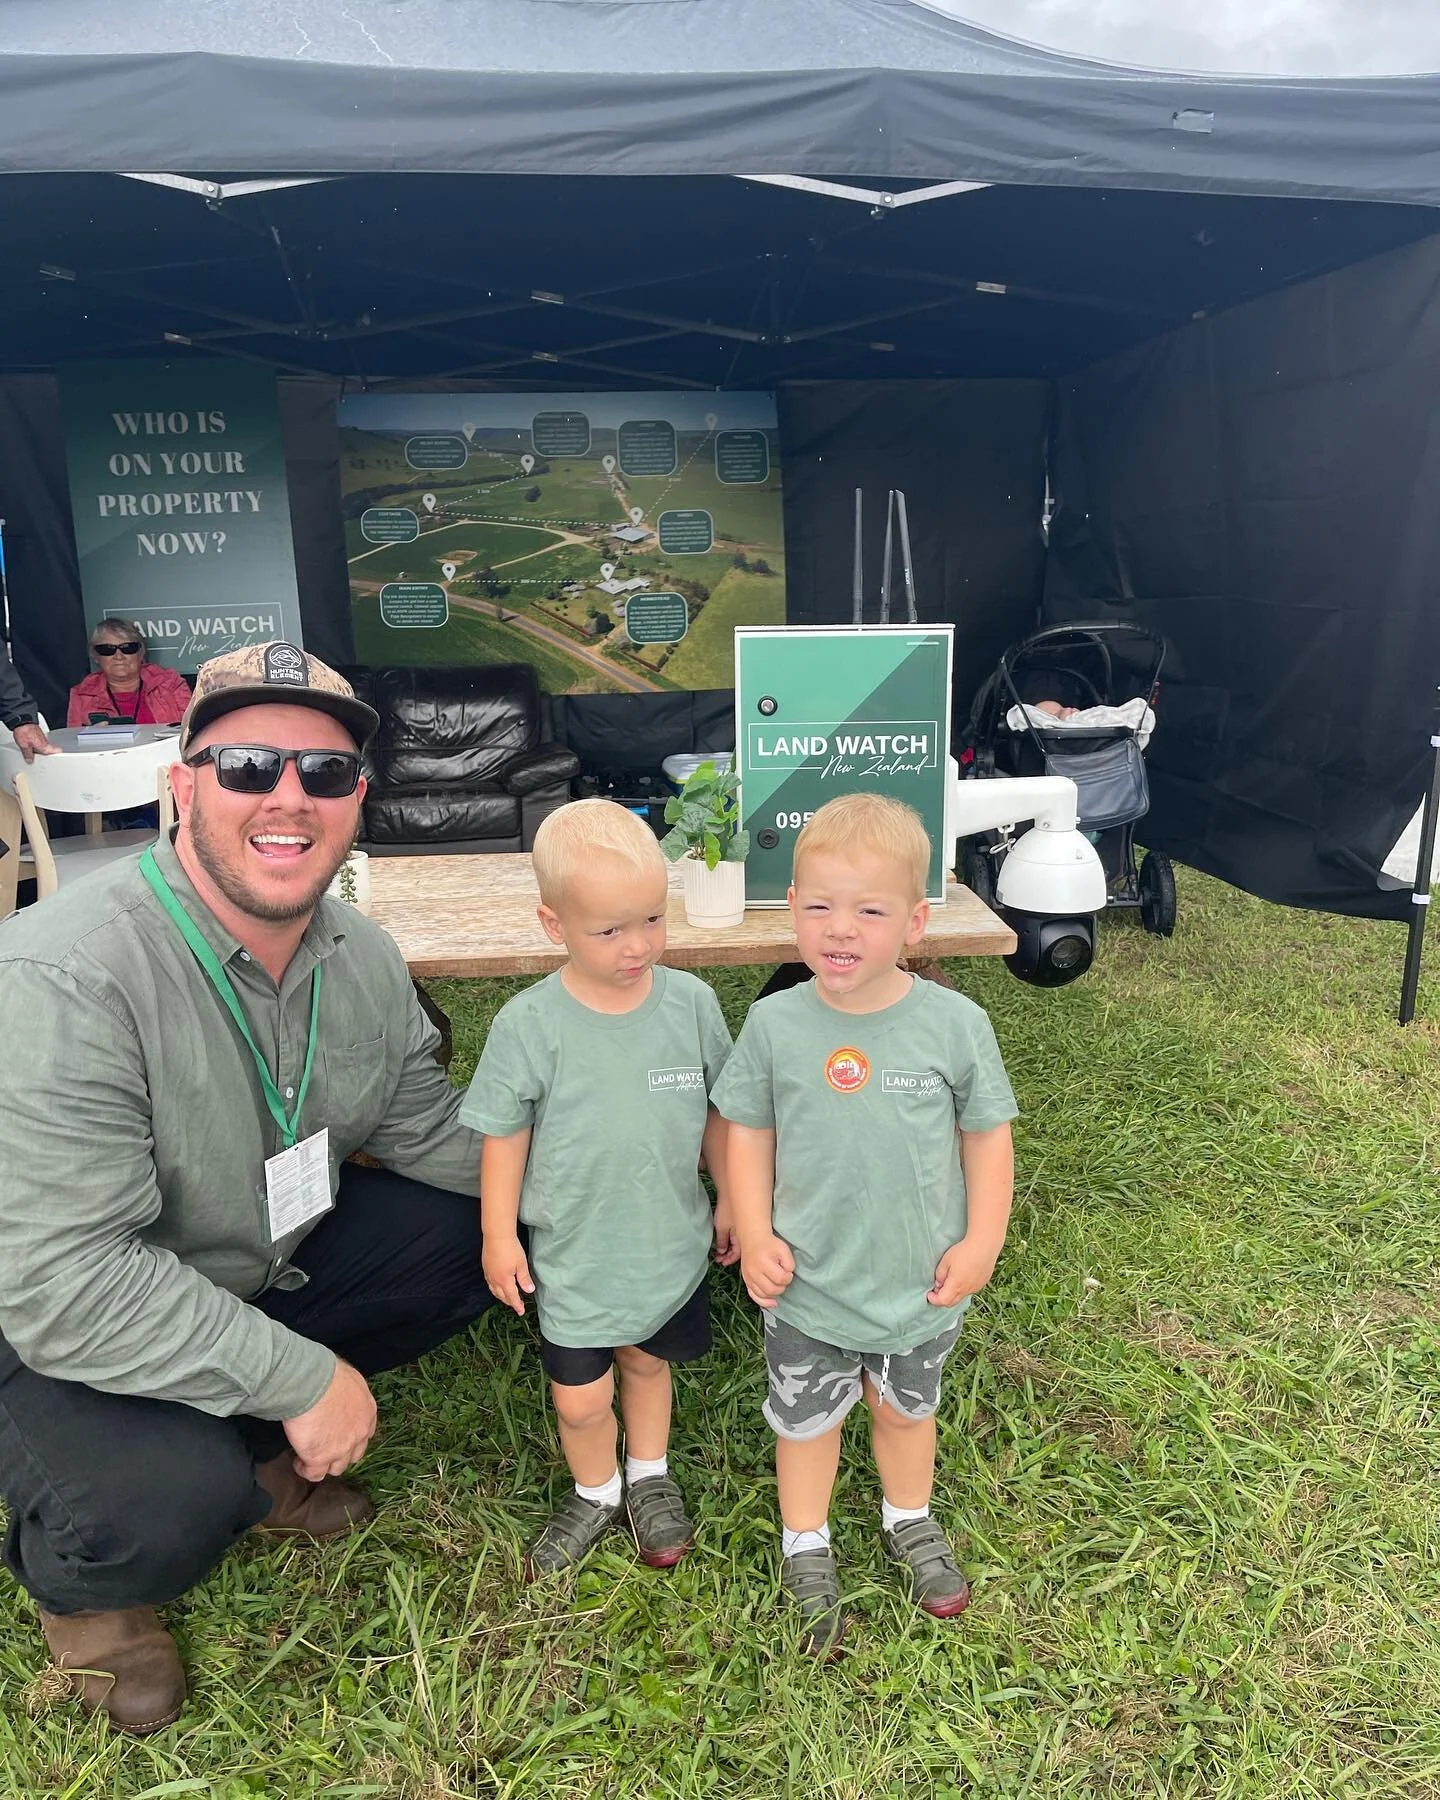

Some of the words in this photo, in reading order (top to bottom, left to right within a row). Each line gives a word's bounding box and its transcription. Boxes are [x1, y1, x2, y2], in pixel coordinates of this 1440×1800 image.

[112, 411, 190, 436] WHO
[198, 411, 226, 434] IS
[109, 453, 152, 477] ON
[160, 451, 246, 475] YOUR
[97, 490, 264, 517] PROPERTY
[137, 531, 228, 556] NOW?
[132, 617, 182, 638] AND
[187, 615, 275, 636] WATCH
[177, 635, 208, 658] New
[270, 668, 304, 677] HUNTERS
[270, 673, 304, 682] ELEMENT
[757, 736, 828, 757] LAND
[835, 735, 928, 755] WATCH
[820, 755, 855, 779] New
[858, 755, 929, 776] Zealand
[651, 1074, 675, 1085] LAND
[676, 1072, 704, 1082] WATC
[886, 1076, 917, 1088] LAND
[920, 1075, 944, 1087] WATC
